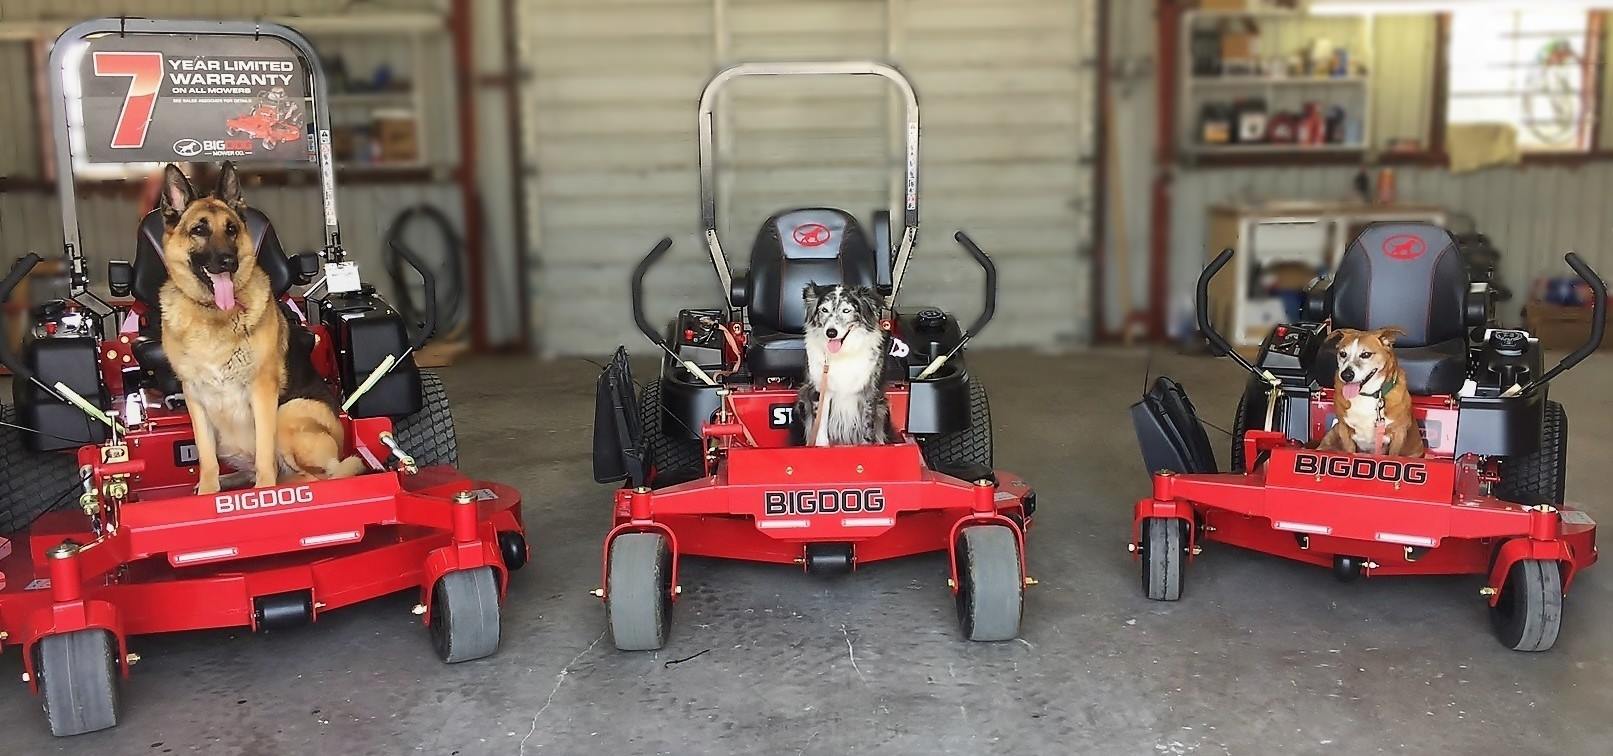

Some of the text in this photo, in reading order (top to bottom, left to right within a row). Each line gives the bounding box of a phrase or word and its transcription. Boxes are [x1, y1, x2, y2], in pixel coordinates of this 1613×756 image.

[168, 59, 294, 72] YEAR LIMITED
[168, 73, 293, 86] WARRANTY
[92, 51, 165, 149] 7
[1294, 453, 1428, 485] BIGDOG
[215, 485, 314, 514] BIGDOG
[764, 487, 886, 516] BIGDOG
